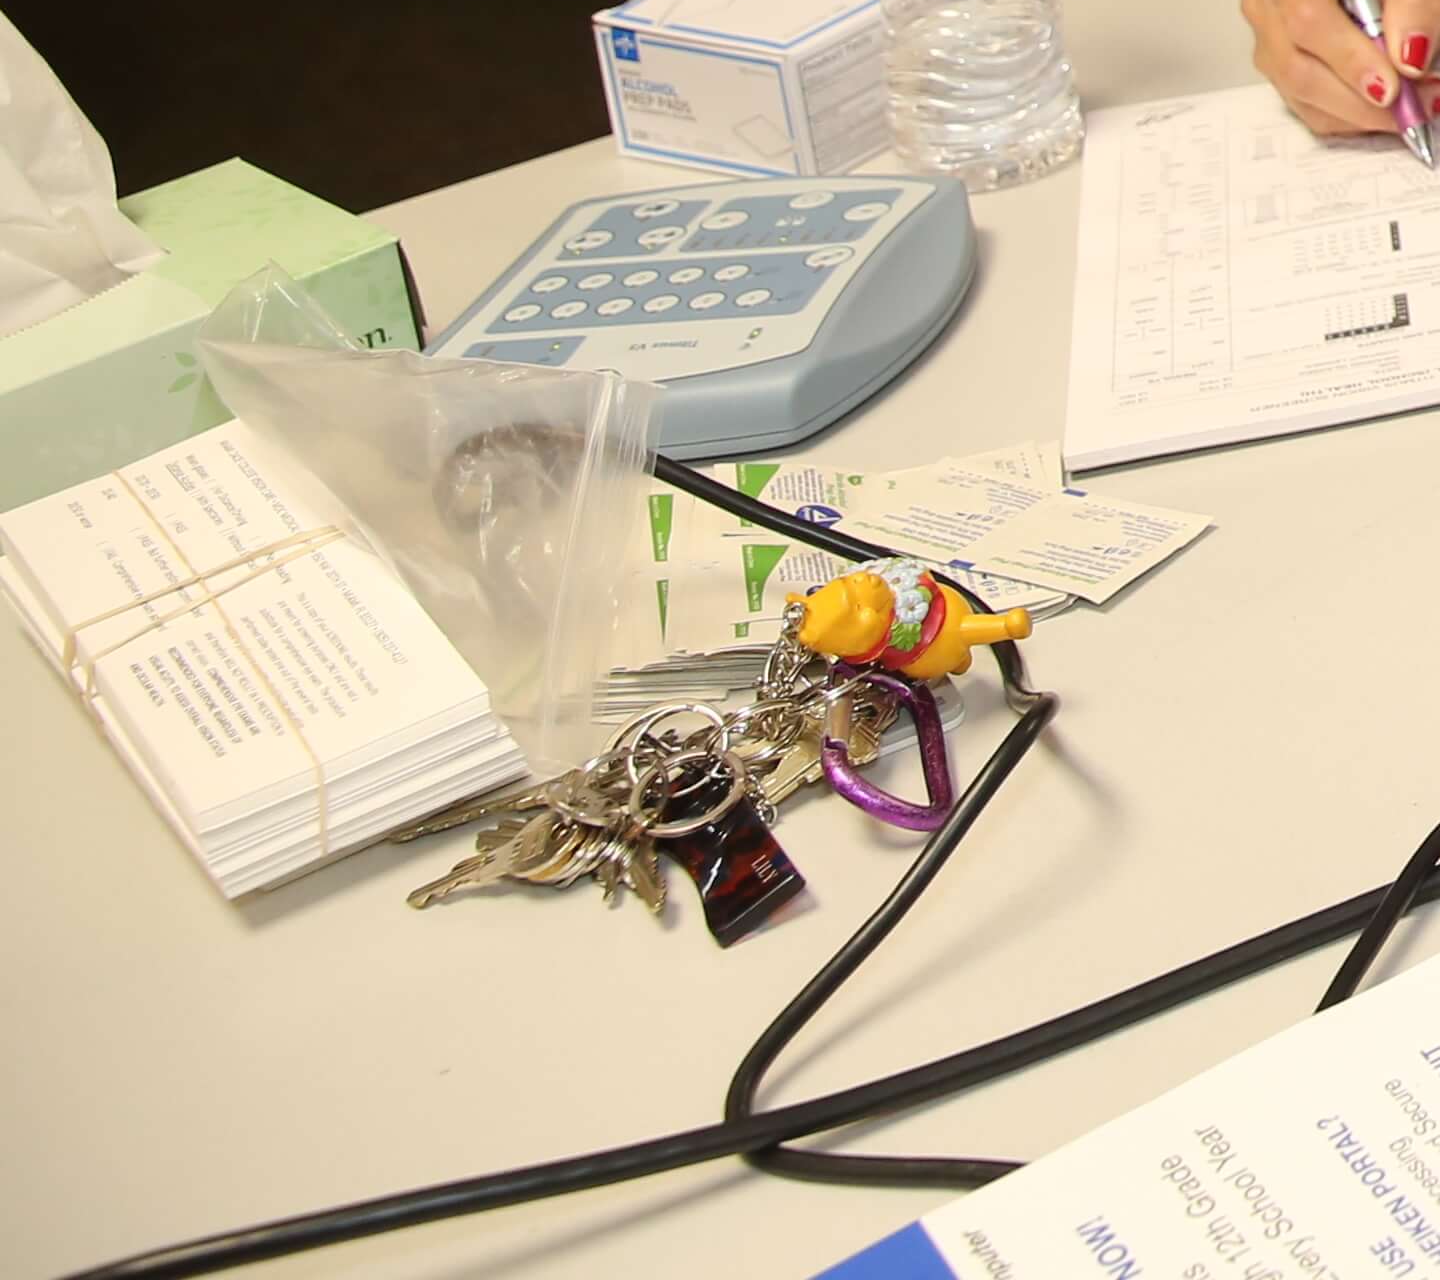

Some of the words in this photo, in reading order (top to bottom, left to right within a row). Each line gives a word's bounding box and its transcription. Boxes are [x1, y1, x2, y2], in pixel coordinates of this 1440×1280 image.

[1384, 1079, 1437, 1136] Secure
[1195, 1126, 1236, 1173] Year
[1317, 1116, 1395, 1198] PORTAL?
[1161, 1155, 1216, 1218] Grade
[1224, 1168, 1293, 1239] School
[1076, 1215, 1143, 1280] NOW!
[1206, 1216, 1250, 1263] 12th
[1284, 1235, 1339, 1280] very
[1370, 1237, 1415, 1278] USE
